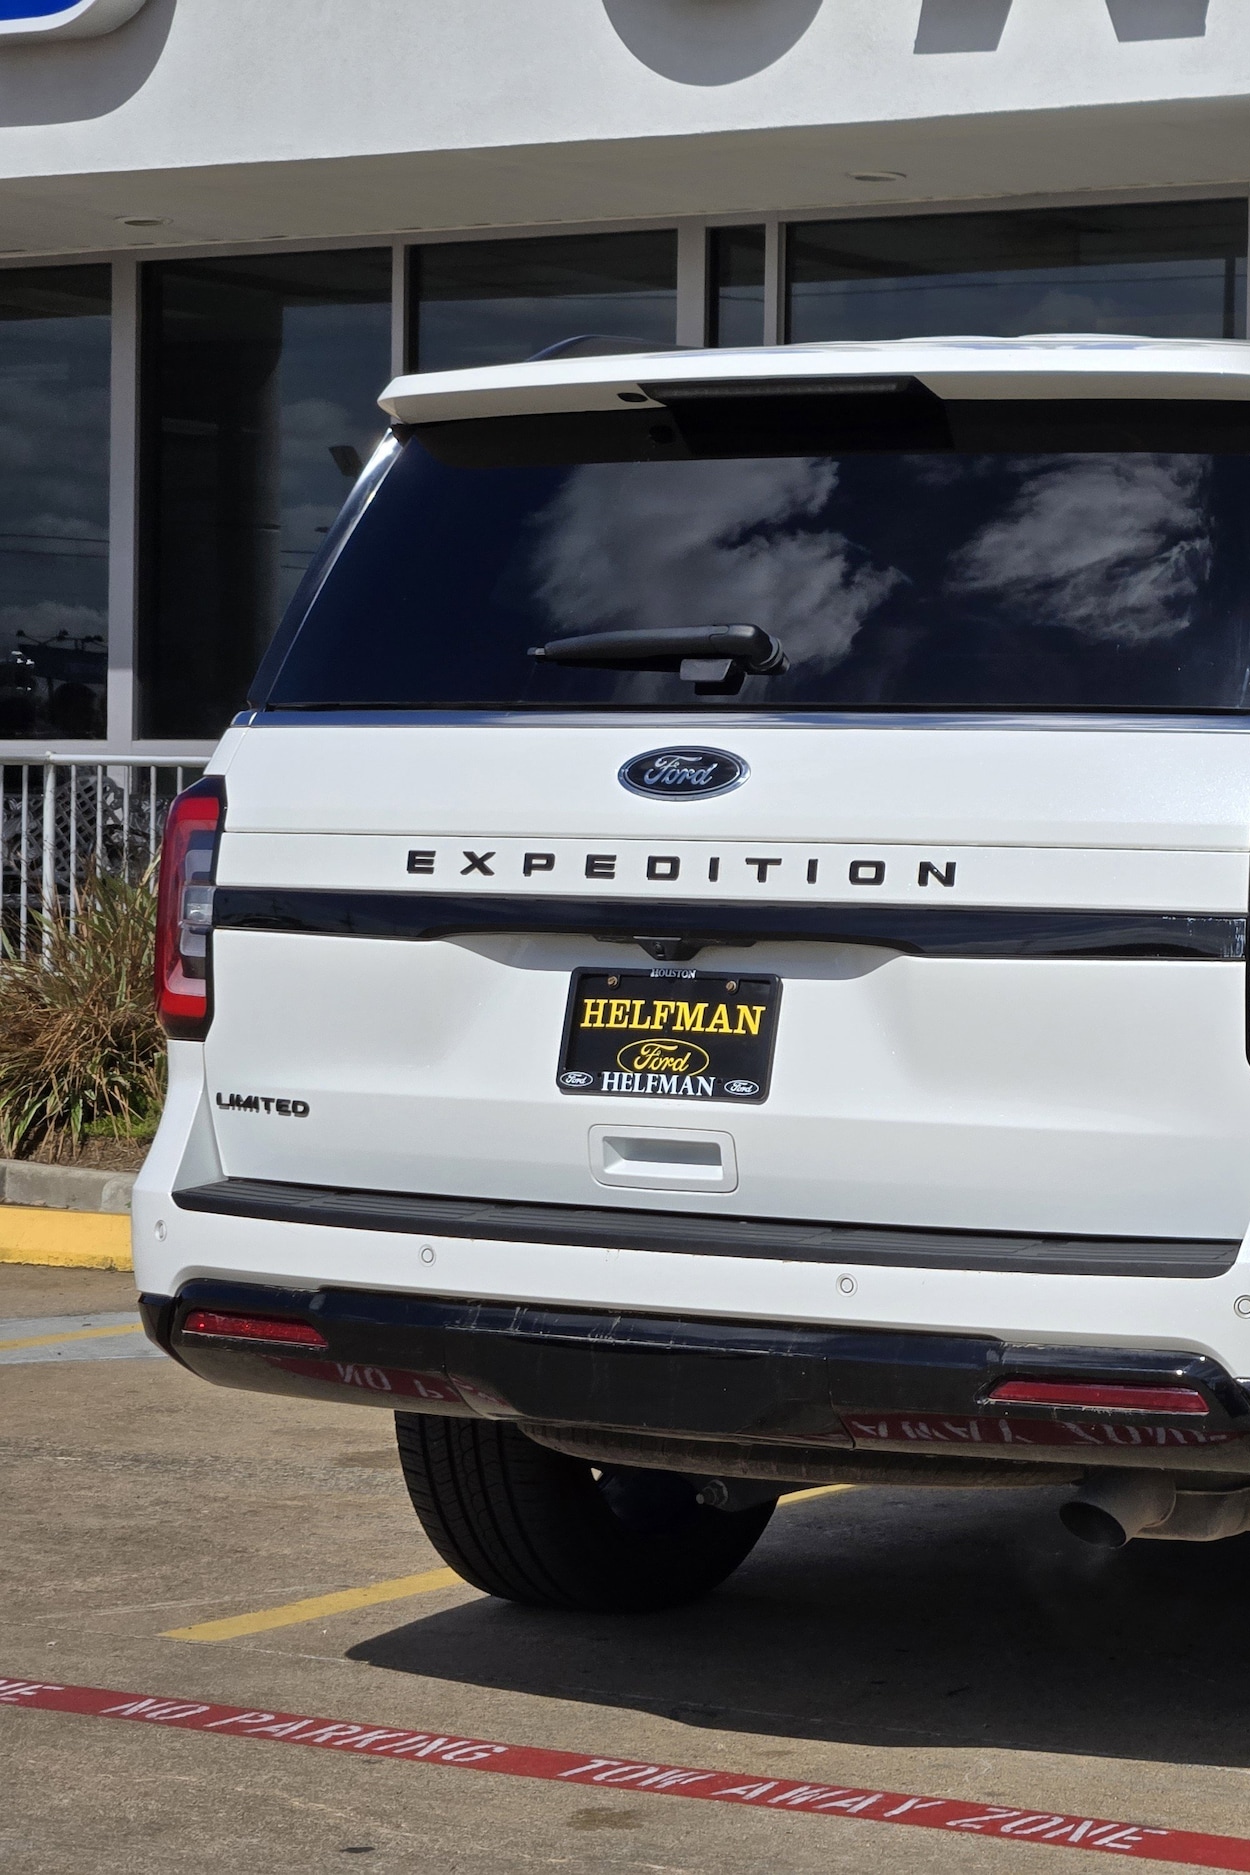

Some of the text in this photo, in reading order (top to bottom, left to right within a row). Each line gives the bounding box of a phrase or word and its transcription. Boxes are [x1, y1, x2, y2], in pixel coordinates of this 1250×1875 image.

[643, 754, 719, 786] Ford
[406, 849, 957, 888] EXPEDITION
[650, 967, 696, 979] HOUSTON
[580, 998, 766, 1034] HELFMAN
[633, 1042, 690, 1073] Ford
[601, 1071, 715, 1096] HELFMAN
[216, 1091, 311, 1118] LIMITED
[100, 1698, 1170, 1850] NO PARKING TOW AWAY ZONE
